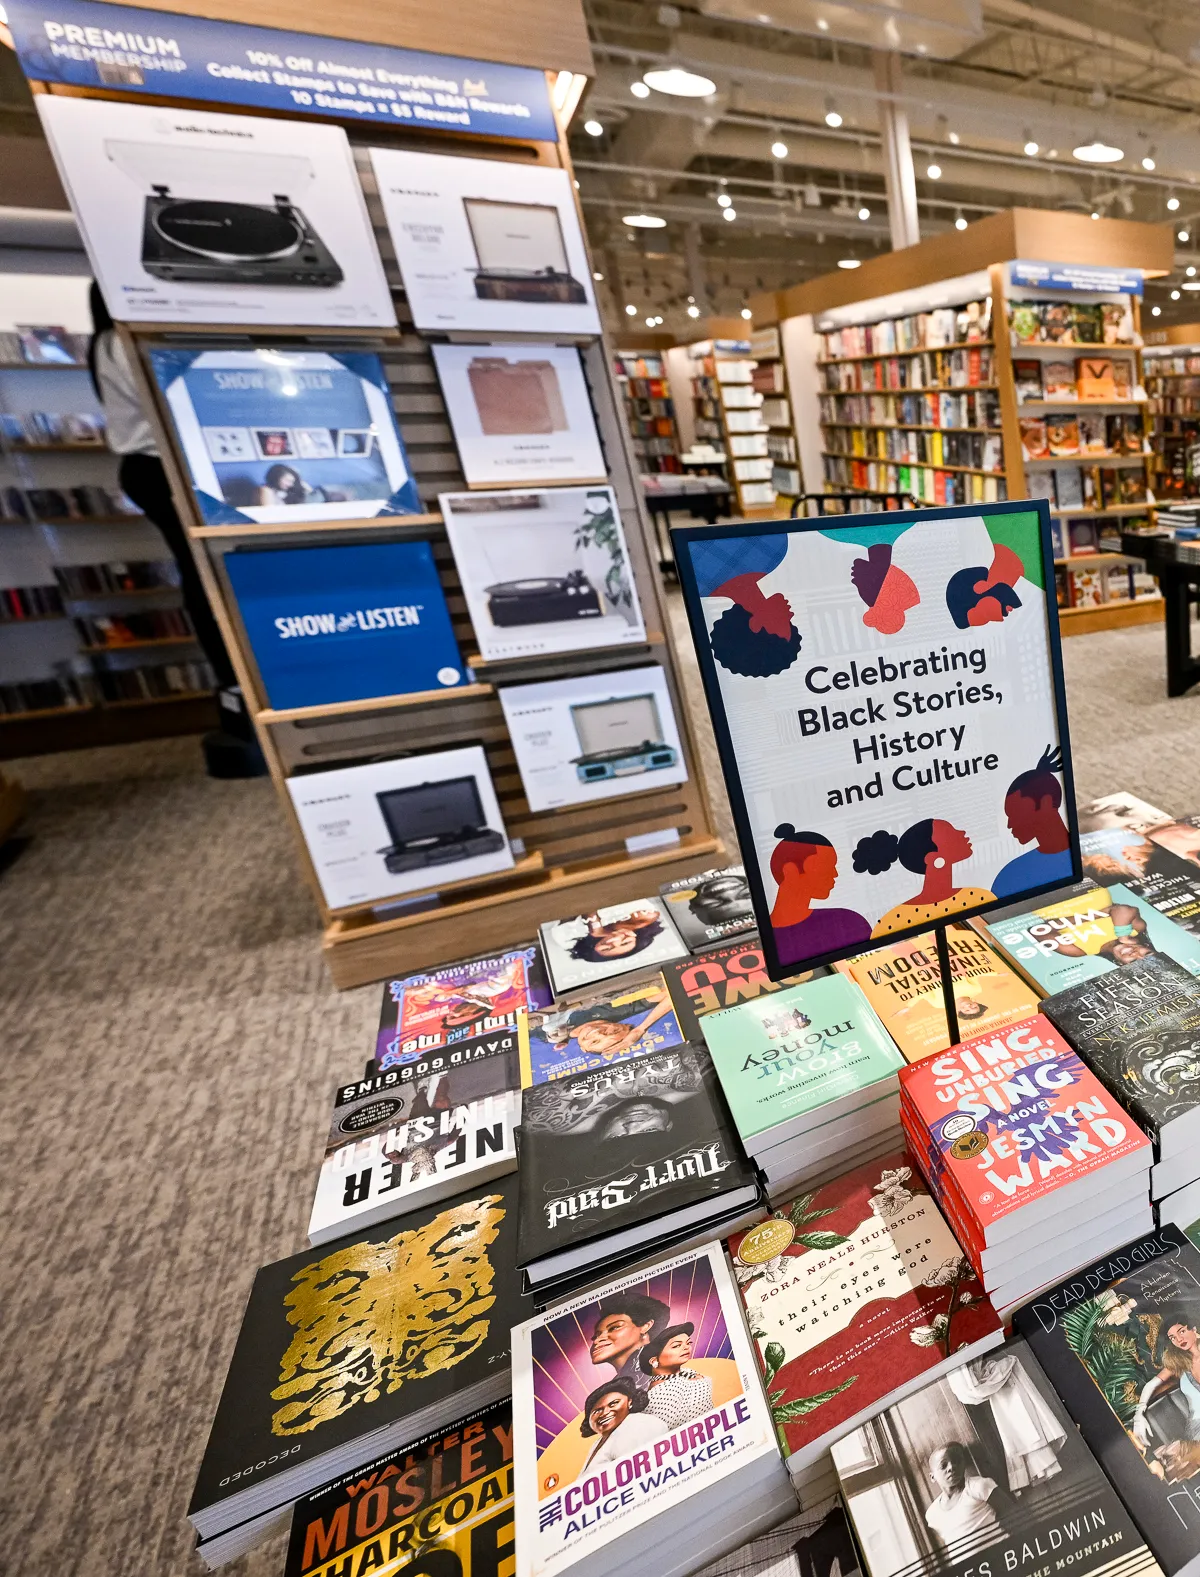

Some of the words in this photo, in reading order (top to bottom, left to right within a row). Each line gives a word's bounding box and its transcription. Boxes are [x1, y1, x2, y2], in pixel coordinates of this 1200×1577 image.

[44, 20, 181, 58] PREMIUM
[50, 43, 187, 73] MEMBERSHIP
[206, 62, 272, 84] Collect
[271, 71, 336, 93] Stamps
[336, 80, 357, 95] to
[357, 83, 397, 100] Save
[397, 89, 434, 106] with
[468, 97, 531, 118] Rewards
[246, 50, 284, 69] 10%
[375, 69, 459, 95] Everything
[290, 89, 313, 106] 10
[314, 93, 376, 115] Stamps
[413, 105, 472, 125] Reward
[273, 612, 337, 640] SHOW
[356, 604, 421, 632] LISTEN
[804, 646, 988, 695] Celebrating
[797, 701, 886, 738] Black
[894, 683, 1003, 720] Stories,
[852, 723, 966, 765] History
[826, 772, 885, 809] and
[892, 751, 1000, 792] Culture
[1015, 924, 1108, 960] Made
[917, 973, 963, 996] JONEY
[967, 966, 995, 978] YOUR
[1080, 971, 1157, 1010] FIFTH
[1094, 973, 1124, 988] THE
[1078, 976, 1184, 1028] SEASON
[402, 1033, 442, 1055] me
[451, 1038, 513, 1063] DAVID
[740, 1020, 856, 1072] money
[935, 1049, 958, 1063] YORK
[991, 1019, 1038, 1040] BESTSELLER
[1082, 1026, 1105, 1038] EVERY
[343, 1057, 444, 1099] GOGGINS
[548, 1059, 600, 1081] CRIME
[571, 1059, 681, 1098] TYRUS
[757, 1039, 839, 1080] your
[776, 1041, 863, 1087] grow
[931, 1028, 1055, 1086] SING,
[935, 1047, 1065, 1103] UNBURIED,
[787, 1073, 828, 1093] investing
[956, 1063, 1075, 1122] SING
[977, 1095, 1109, 1170] JESMYN
[1010, 1100, 1056, 1124] NOVEL
[984, 1118, 1127, 1197] WARD
[760, 1276, 801, 1303] ZORA
[806, 1244, 856, 1276] NEALE
[860, 1208, 926, 1246] HURSTON
[543, 1311, 562, 1323] NOW
[570, 1300, 588, 1313] NEW
[588, 1288, 614, 1302] MAJOR
[614, 1275, 644, 1291] MOTION
[644, 1263, 675, 1280] PICTURE
[675, 1253, 699, 1266] EVENT
[778, 1293, 828, 1327] their
[840, 1264, 880, 1290] eyes
[891, 1237, 932, 1262] were
[795, 1277, 887, 1334] watching
[897, 1254, 929, 1277] god
[1031, 1284, 1087, 1334] DEAD
[1085, 1257, 1132, 1290] DEAD
[1131, 1232, 1182, 1263] GIRLS
[1143, 1278, 1180, 1301] Renaissance
[1154, 1289, 1182, 1306] Mystery
[866, 1307, 891, 1324] novel
[892, 1305, 926, 1326] important
[219, 1444, 302, 1488] DECODED
[309, 1485, 332, 1502] WINNER
[354, 1463, 375, 1477] GRAND
[375, 1452, 398, 1467] MASTER
[398, 1441, 419, 1455] AWARD
[440, 1419, 466, 1435] MYSTERY
[345, 1420, 486, 1498] WALTER
[538, 1496, 562, 1534] THE
[565, 1450, 651, 1517] COLOR
[654, 1398, 751, 1468] PURPLE
[301, 1423, 513, 1572] MOSLEY
[563, 1487, 635, 1540] ALICE
[639, 1434, 735, 1494] WALKER
[599, 1509, 632, 1530] PULITZER
[681, 1465, 713, 1484] NATIONAL
[303, 1462, 514, 1577] HARCOA
[1003, 1508, 1106, 1571] BALDWIN
[1055, 1530, 1124, 1571] MOUNTAIN
